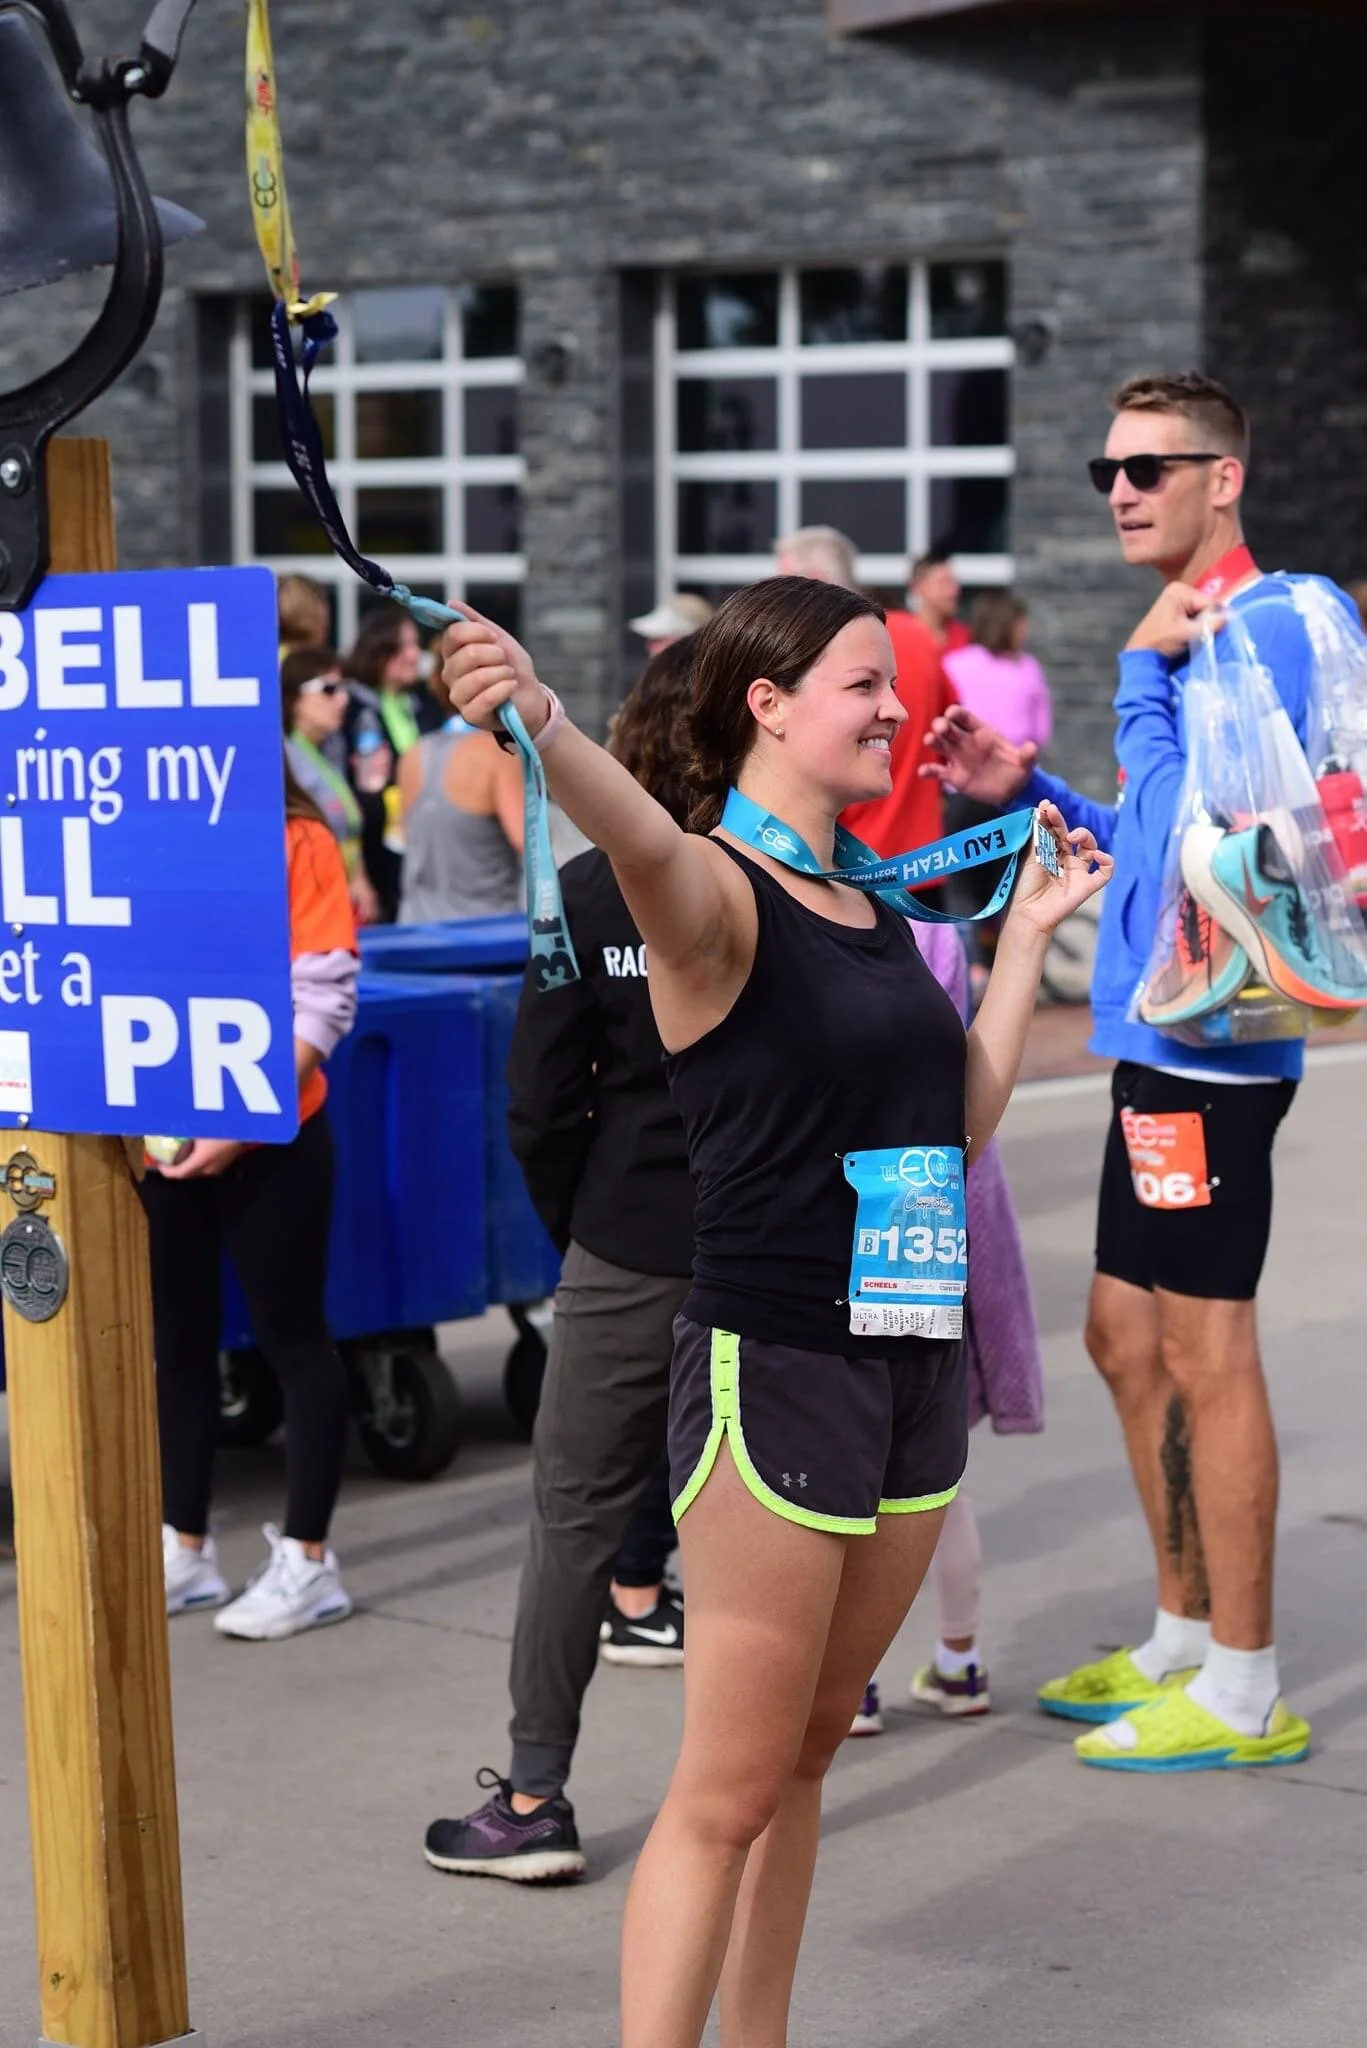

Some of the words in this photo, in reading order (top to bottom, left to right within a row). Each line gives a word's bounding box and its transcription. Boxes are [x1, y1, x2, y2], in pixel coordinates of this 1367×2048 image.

[16, 727, 123, 825] ring
[147, 745, 236, 825] my
[963, 828, 1006, 859] EAU
[874, 866, 898, 879] 2021
[902, 846, 960, 880] YEAH
[61, 952, 92, 1006] a
[100, 995, 282, 1114] PR
[899, 1149, 949, 1187] EC
[1132, 1171, 1196, 1205] 06
[863, 1236, 873, 1252] B
[863, 1281, 898, 1289] SCHEELS
[853, 1312, 879, 1320] ULTRA
